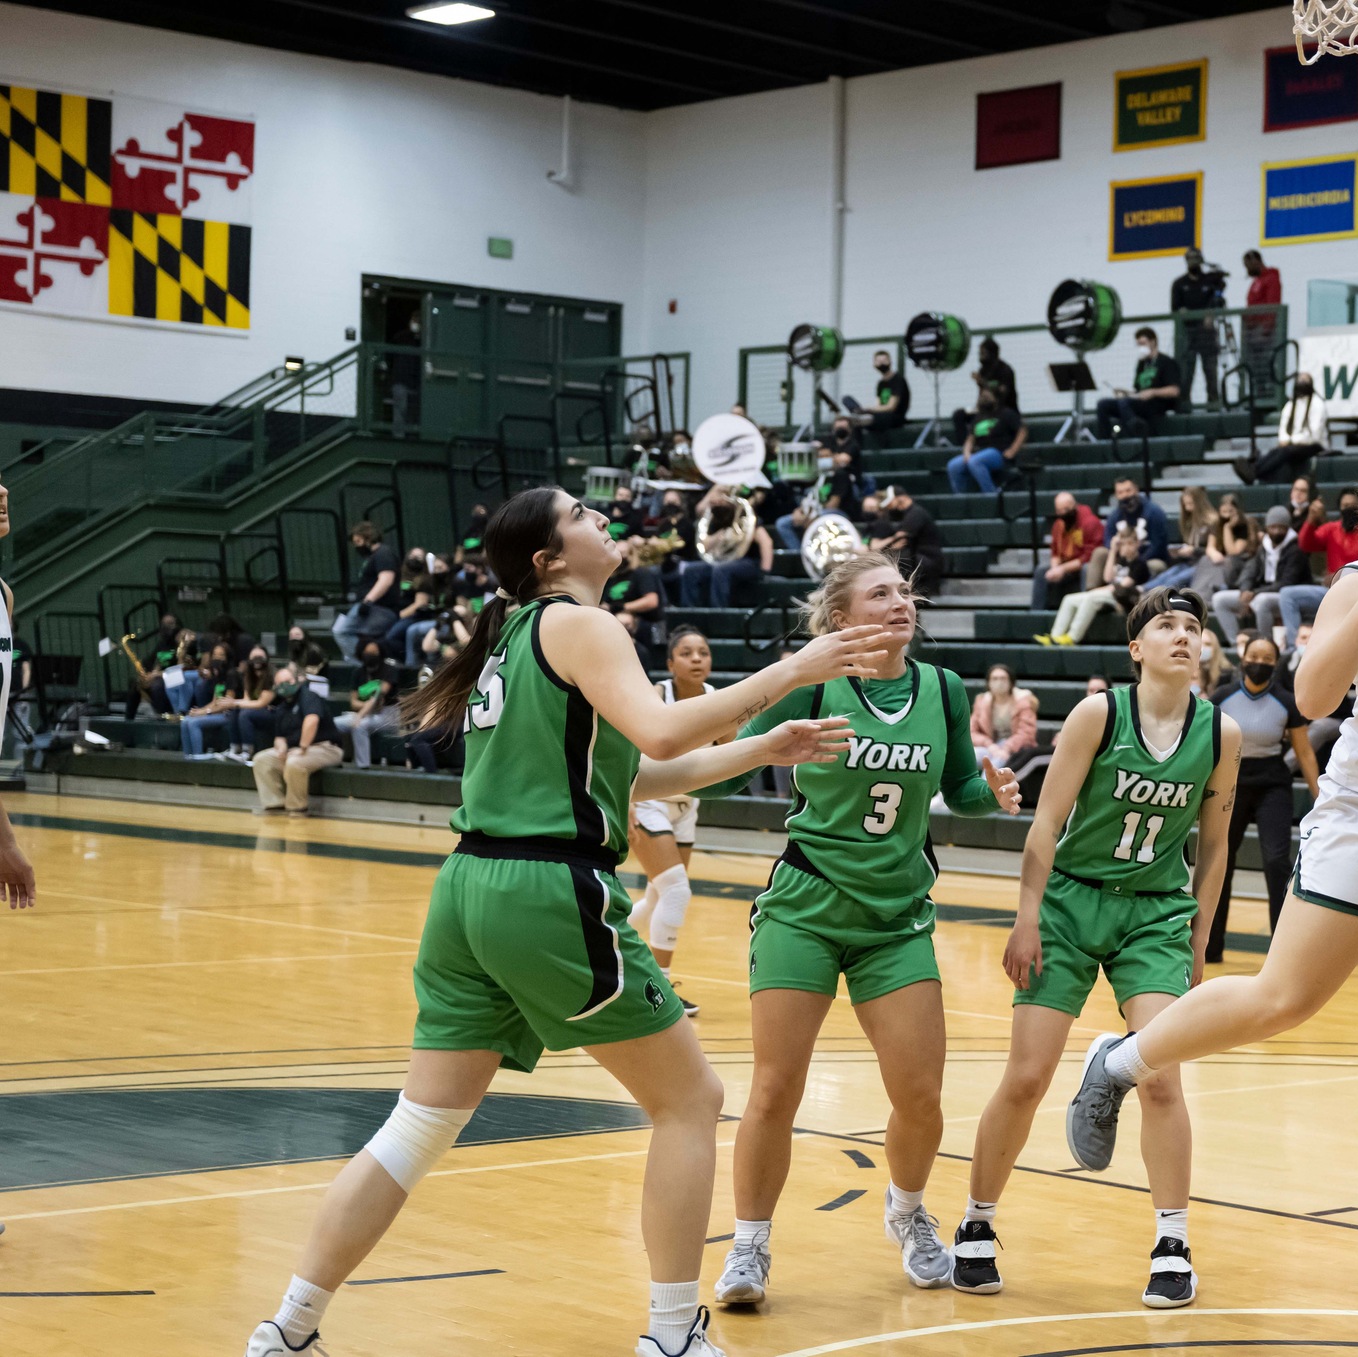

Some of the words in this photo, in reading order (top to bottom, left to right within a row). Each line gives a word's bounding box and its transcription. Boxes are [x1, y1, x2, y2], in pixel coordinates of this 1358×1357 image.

[1126, 84, 1193, 111] DELAWARE
[1136, 105, 1182, 127] VALLEY
[1268, 188, 1350, 211] MISERICORDIA
[1123, 206, 1186, 229] LYCOMING
[847, 736, 932, 773] YORK
[1112, 768, 1195, 808] YORK
[862, 782, 903, 835] 3
[1112, 810, 1165, 865] 11
